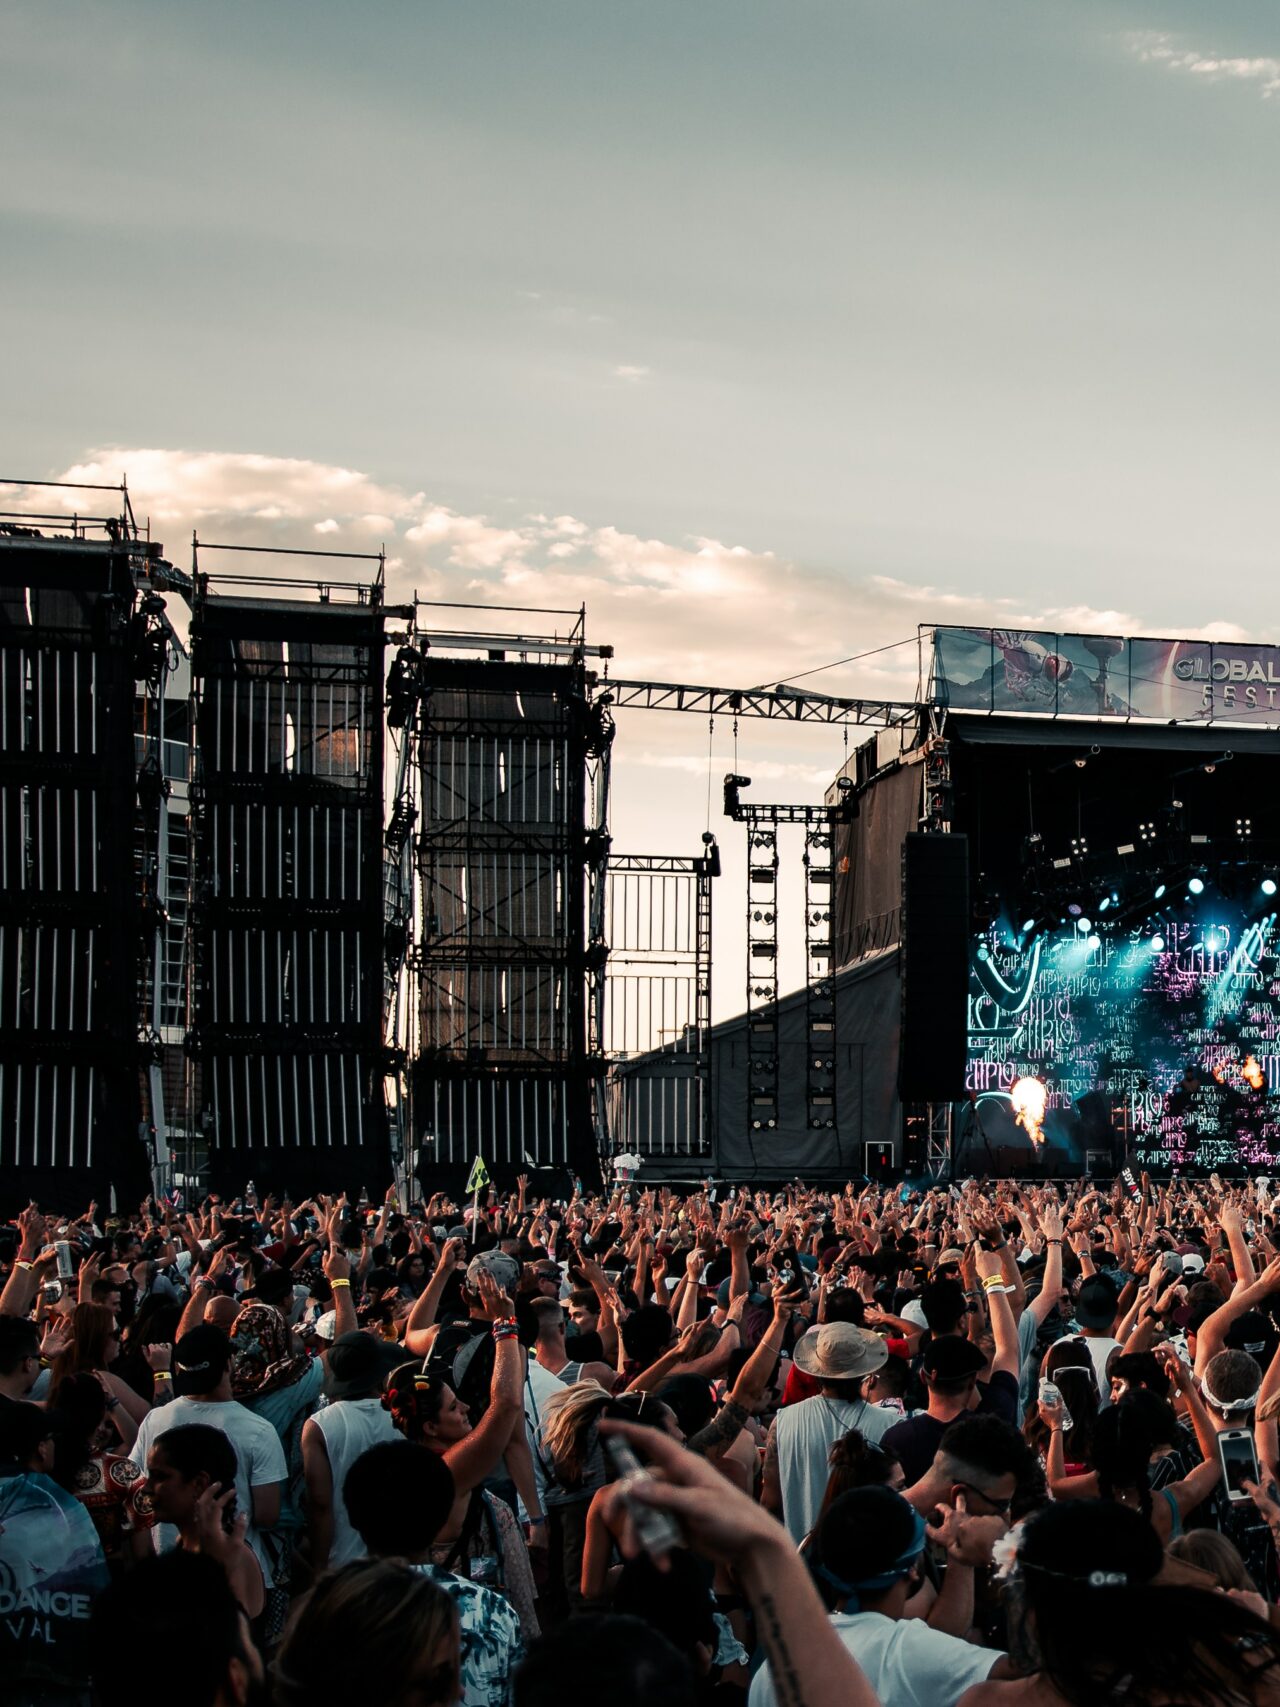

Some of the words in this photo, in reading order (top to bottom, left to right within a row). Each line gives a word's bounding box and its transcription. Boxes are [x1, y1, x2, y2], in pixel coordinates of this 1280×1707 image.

[1122, 1167, 1143, 1204] SAVAGE
[0, 1586, 91, 1619] DANCE
[5, 1616, 57, 1643] VAL
